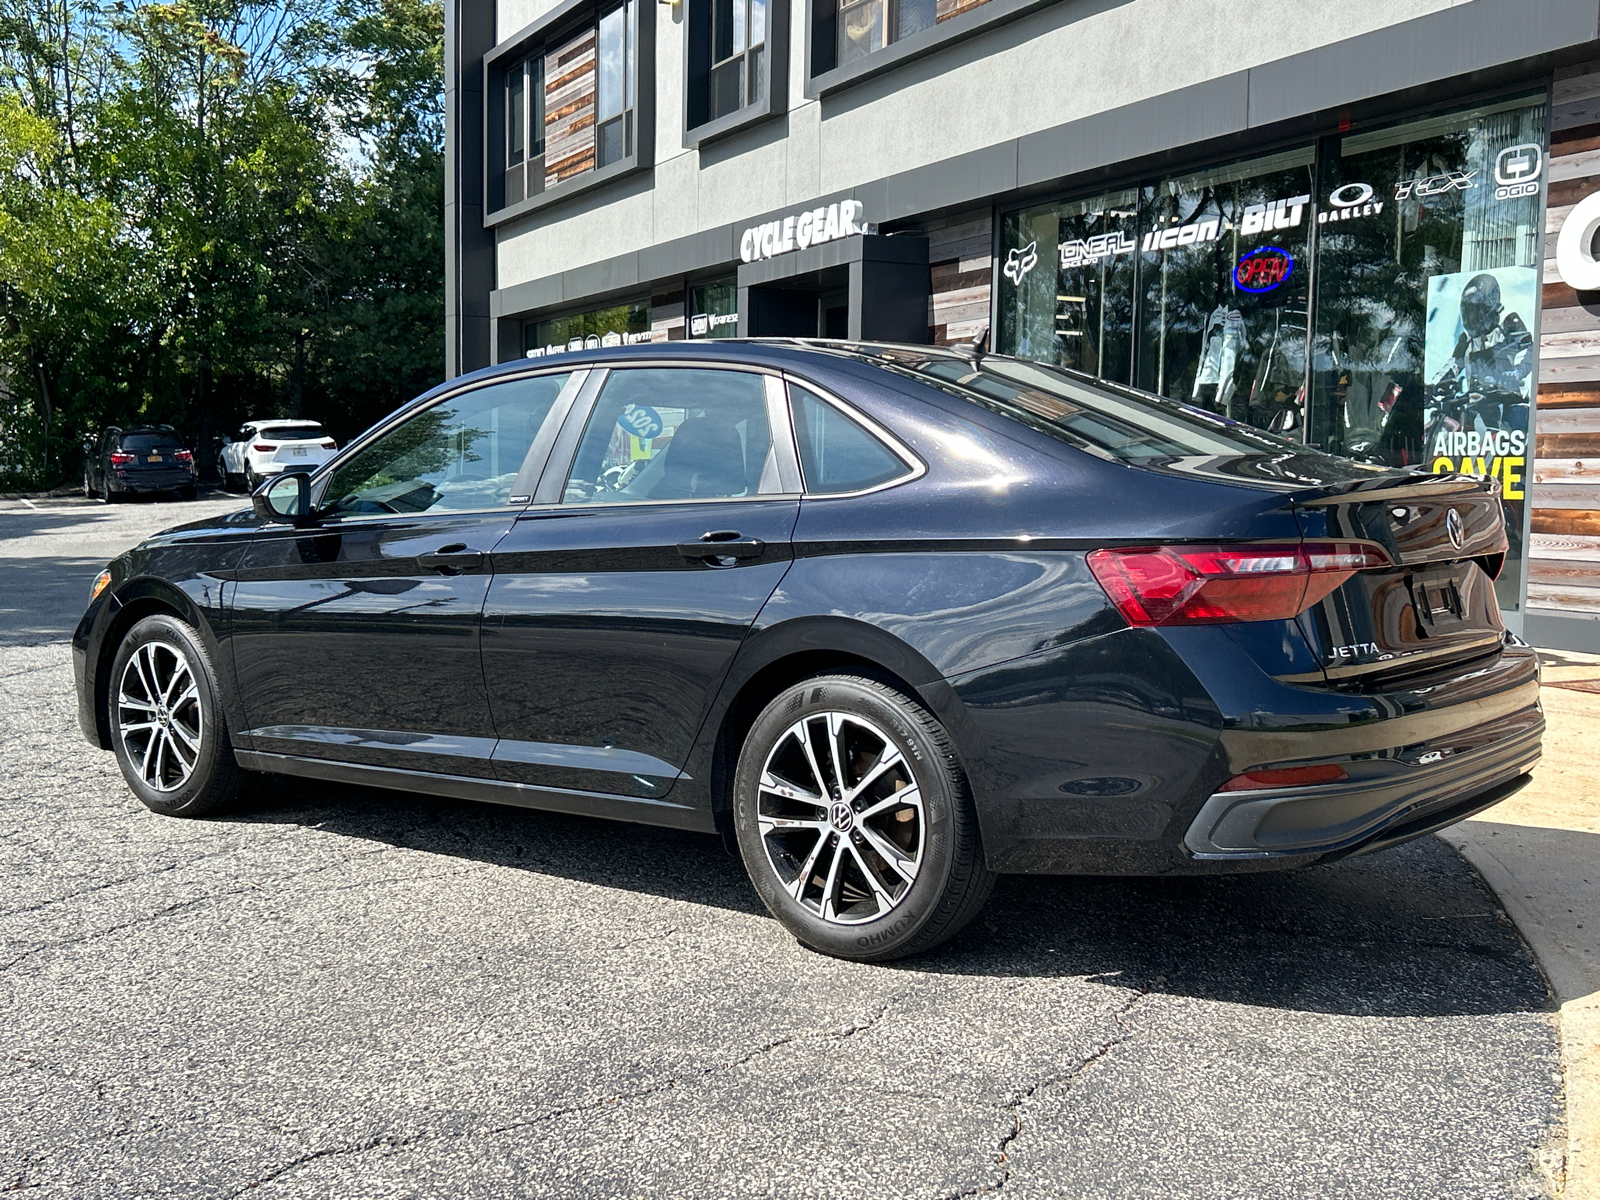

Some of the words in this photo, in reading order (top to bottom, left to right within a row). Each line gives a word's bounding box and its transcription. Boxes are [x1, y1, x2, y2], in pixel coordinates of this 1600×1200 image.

[1495, 182, 1539, 200] OGIO
[1240, 194, 1310, 236] BILT
[1318, 202, 1384, 224] OAKLEY
[740, 216, 798, 263] CYCLE
[797, 199, 862, 249] GEAR
[1236, 257, 1288, 284] OPEN
[1433, 430, 1525, 456] AIRBAGS
[1328, 642, 1379, 659] JETTA
[889, 718, 909, 738] R17
[906, 738, 923, 761] 91H
[857, 909, 916, 948] KUMHO
